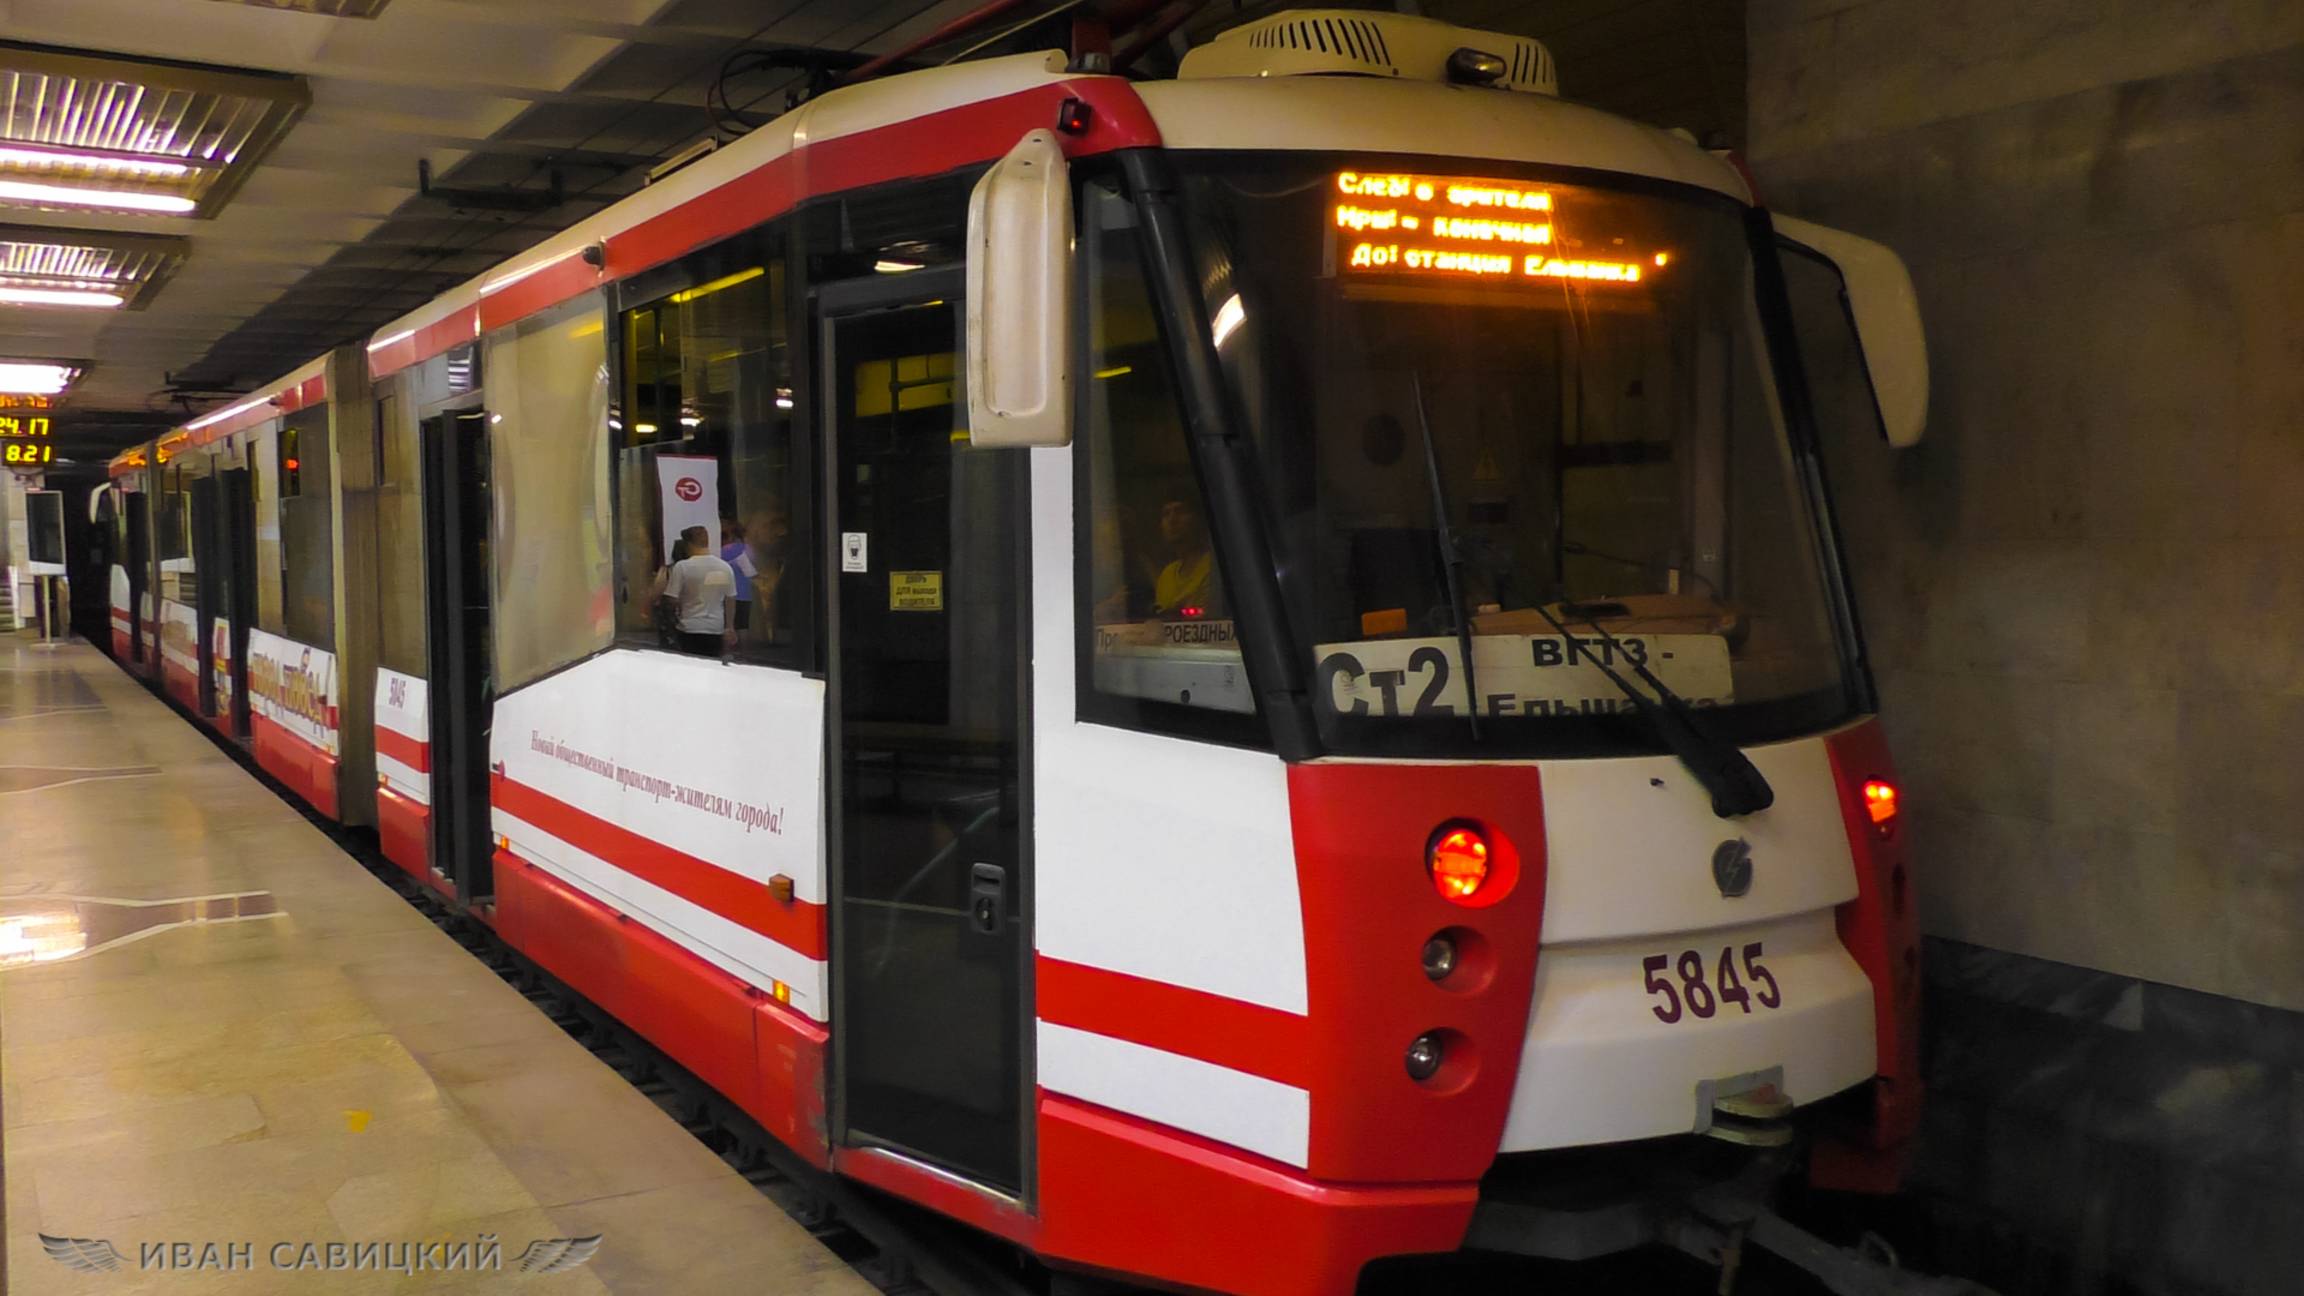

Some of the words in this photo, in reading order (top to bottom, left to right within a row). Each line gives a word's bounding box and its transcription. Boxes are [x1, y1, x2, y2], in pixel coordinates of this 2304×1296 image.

[1532, 638, 1649, 667] ВГТЗ
[1316, 646, 1454, 716] Ст2
[735, 801, 784, 835] города!
[1643, 942, 1781, 1024] 5845
